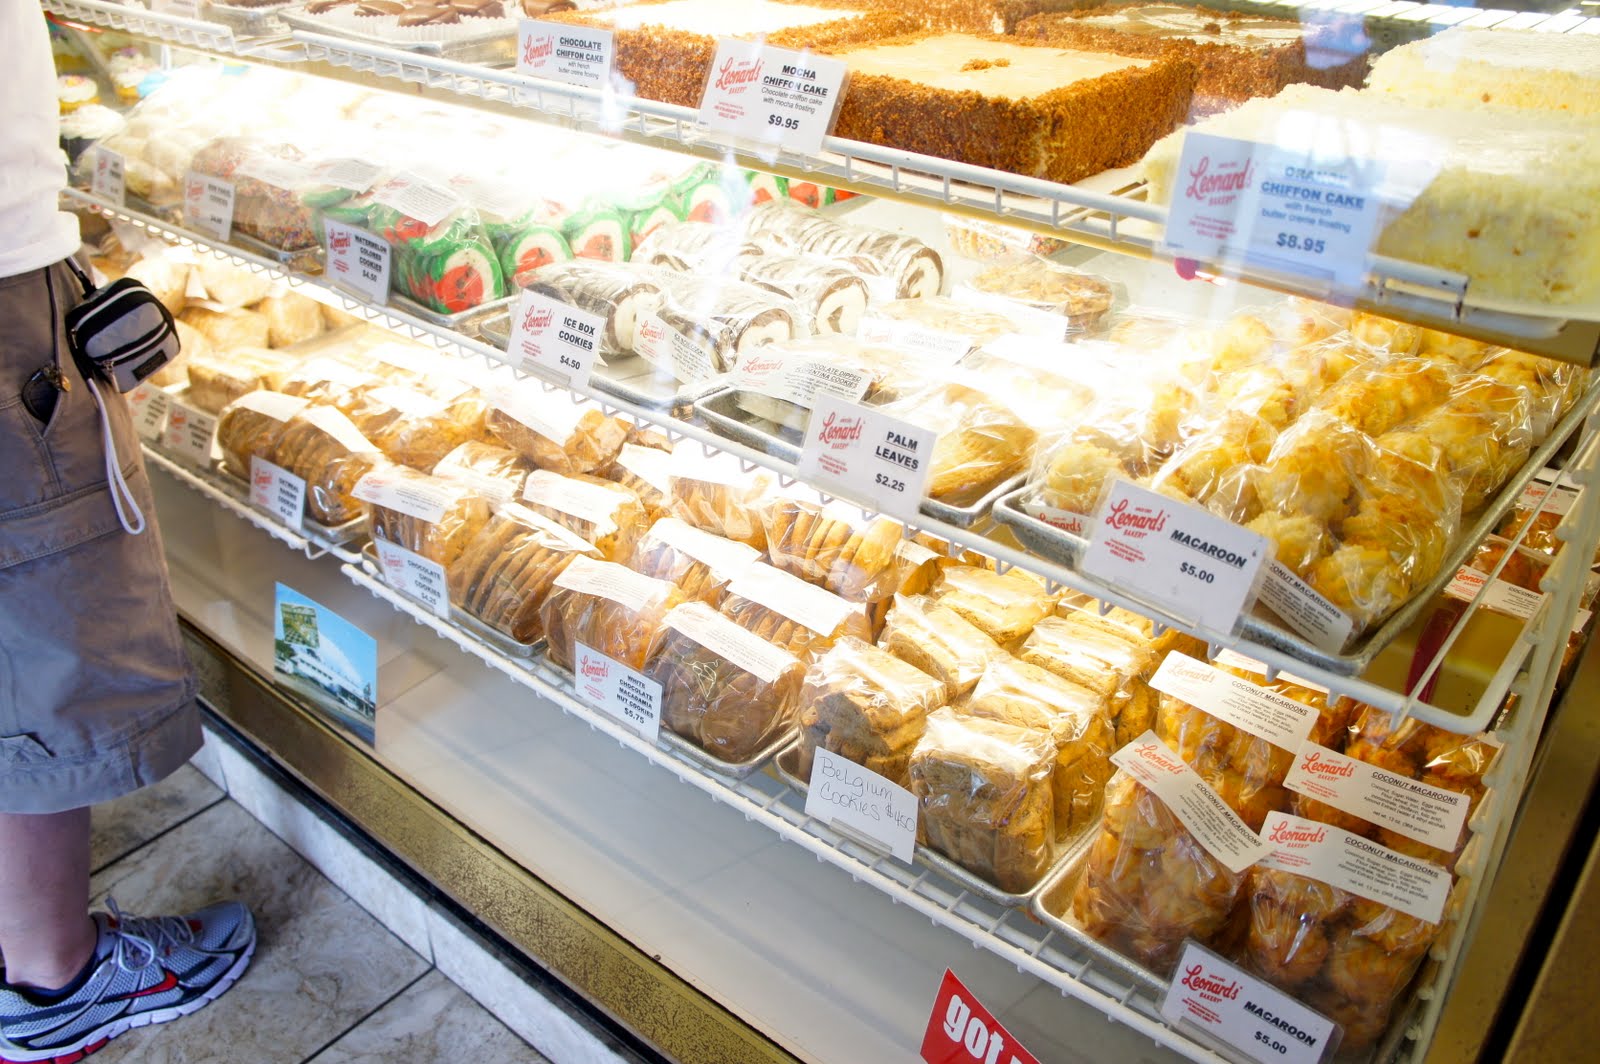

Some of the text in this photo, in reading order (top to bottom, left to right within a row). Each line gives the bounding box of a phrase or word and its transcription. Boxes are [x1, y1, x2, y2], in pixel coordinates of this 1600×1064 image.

[559, 37, 602, 50] CHOCOLATE
[556, 49, 604, 63] CHIFFON CAKE
[782, 65, 816, 80] MOCHA
[762, 87, 823, 106] Chocolate chiffon cake
[763, 76, 829, 97] CHIFFON CAKE
[763, 97, 816, 114] with mocha frosting
[768, 114, 800, 131] $9.95
[1285, 166, 1348, 183] ORA
[1261, 181, 1365, 209] CHIFFON CAKE
[1285, 202, 1333, 216] with french
[1262, 208, 1352, 234] butter creme frosting
[354, 234, 387, 254] WATERMELON
[1276, 232, 1326, 254] $8.95
[360, 256, 382, 272] COOKIES
[363, 269, 378, 282] $4.50
[564, 317, 595, 335] ICE BOX
[559, 330, 593, 351] COOKIES
[560, 355, 580, 370] $4.50
[831, 375, 858, 390] COOKIES
[840, 370, 862, 382] DIPPED
[886, 431, 918, 451] PALM
[875, 446, 919, 470] LEAVES
[875, 473, 905, 493] $2.25
[278, 495, 297, 511] COOKIES
[1105, 499, 1166, 531] Leonard's
[1123, 529, 1148, 539] BAKERY
[1172, 529, 1249, 568] MACAROON
[407, 559, 441, 580] CHOCOLATE
[419, 573, 433, 584] CHIP
[1180, 561, 1215, 585] $5.00
[415, 580, 441, 598] COOKIES
[1294, 581, 1342, 618] MACAROONS
[619, 679, 653, 701] CHOCOLATE
[627, 675, 646, 689] WHITE
[616, 694, 654, 719] NUT COOKIES
[619, 687, 653, 710] MACADAMIA
[1232, 680, 1264, 697] COCONUT
[1265, 694, 1309, 716] MACAROONS
[624, 707, 645, 724] $5.75
[1301, 752, 1354, 777] Leonard's
[1372, 771, 1459, 805] COCONUT MACAROONS
[1196, 783, 1225, 814] COCONUT
[1224, 811, 1262, 847] MACAROONS
[1269, 821, 1325, 844] Leonard's
[1344, 836, 1439, 879] COCONUT MACAROONS
[1182, 964, 1241, 1000] Leonard's
[1199, 992, 1222, 1004] BAKERY
[943, 993, 1005, 1064] got
[1244, 1000, 1317, 1046] MACAROON
[1254, 1031, 1288, 1055] $5.00
